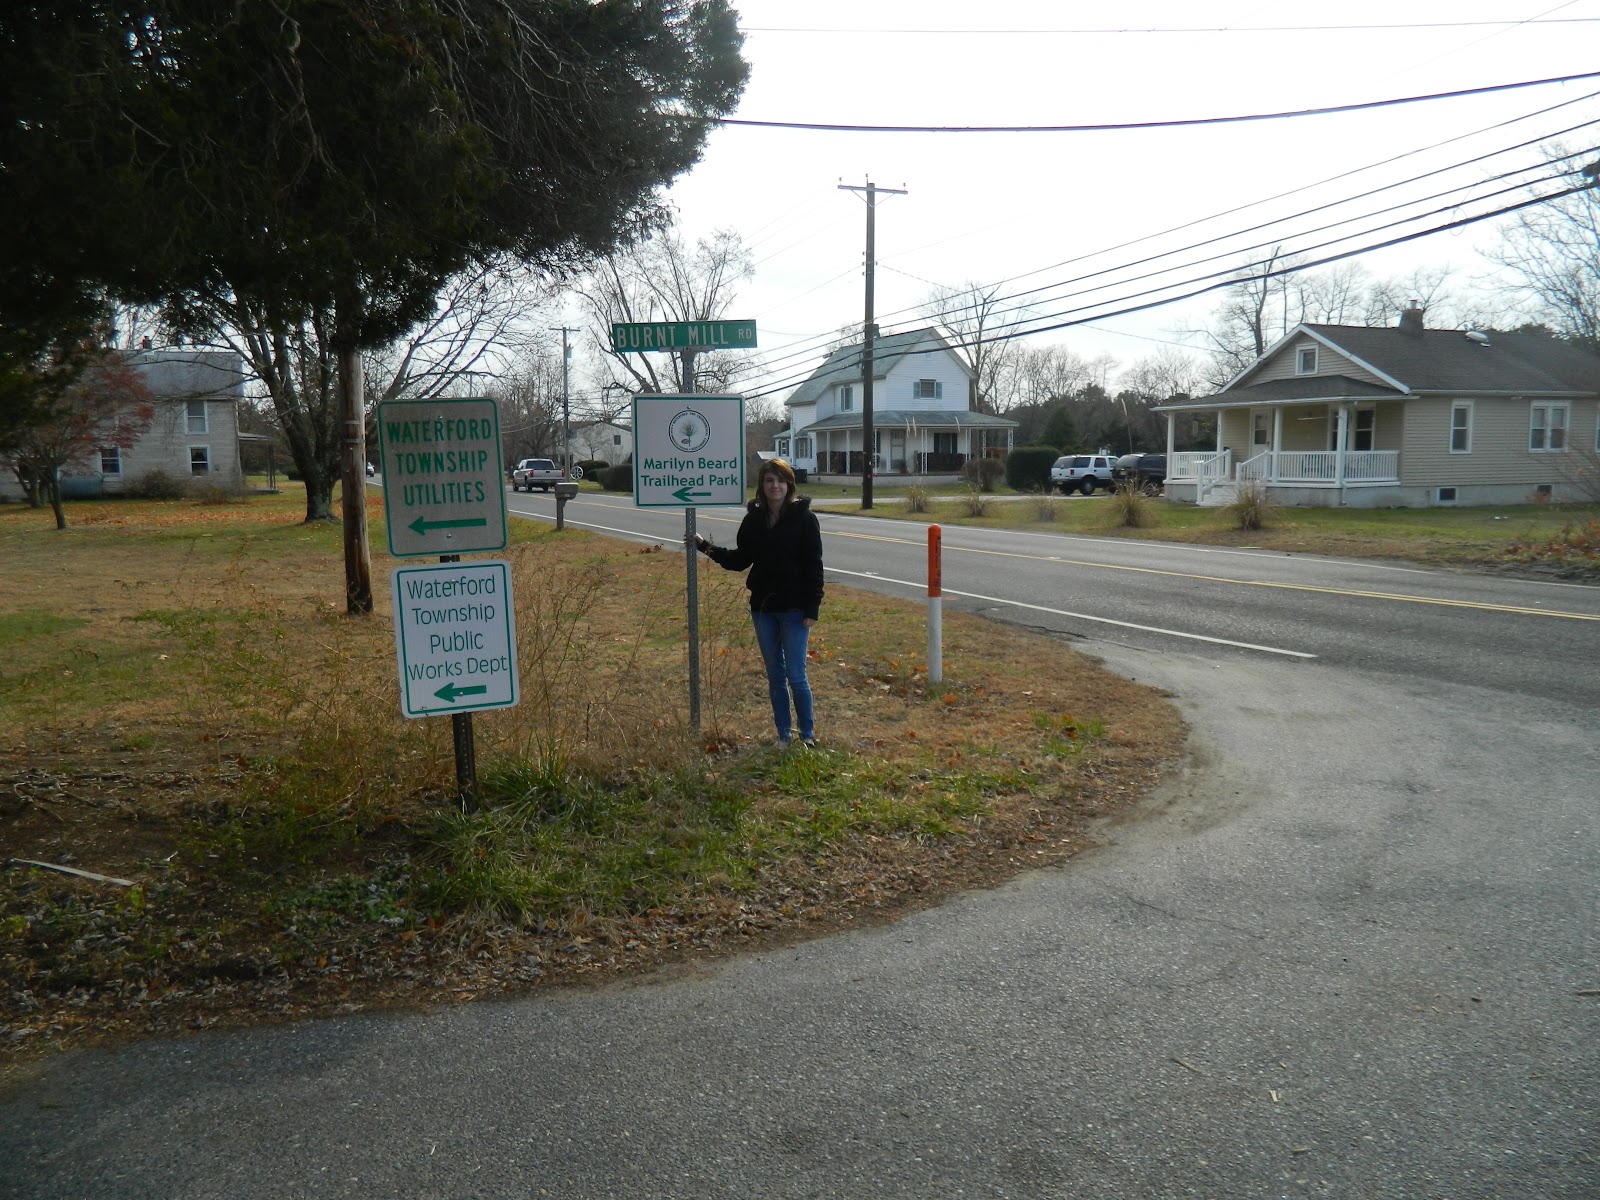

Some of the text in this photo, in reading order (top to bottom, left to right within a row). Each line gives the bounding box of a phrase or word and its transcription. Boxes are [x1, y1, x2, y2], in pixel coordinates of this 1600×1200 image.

[617, 324, 752, 348] BURNT MILL RD
[385, 418, 492, 443] WATERFORD
[395, 450, 488, 475] TOWNSHIP
[643, 457, 737, 472] Marilyn Beard
[641, 474, 738, 487] Trailhead Park
[403, 481, 485, 506] UTILITIES
[406, 574, 495, 599] Waterford
[412, 604, 495, 625] Township
[430, 630, 484, 654] Public
[408, 655, 508, 680] Works Dept
